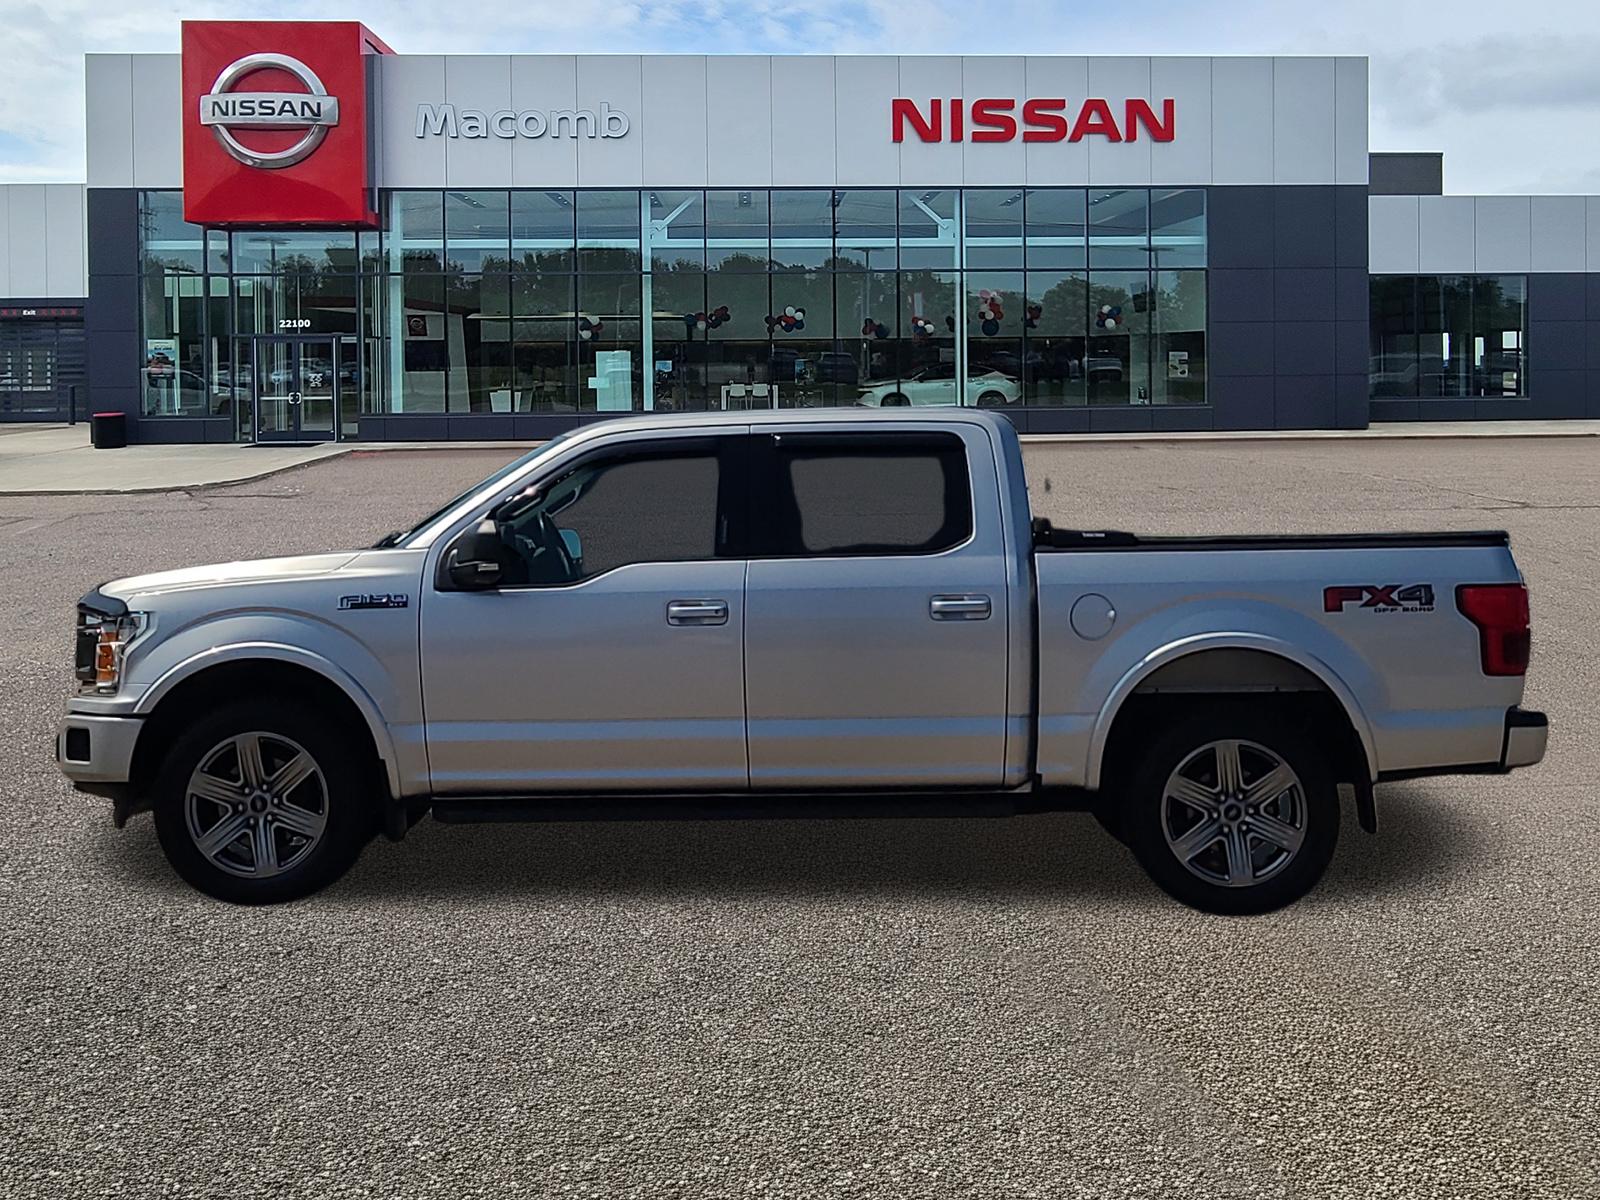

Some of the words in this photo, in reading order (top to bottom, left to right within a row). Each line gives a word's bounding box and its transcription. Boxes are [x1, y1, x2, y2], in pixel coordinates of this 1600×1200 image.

[211, 100, 322, 118] NISSAN
[415, 102, 630, 139] Macomb
[891, 98, 1175, 144] NISSAN
[279, 319, 311, 328] 22100
[1322, 583, 1435, 613] FX4
